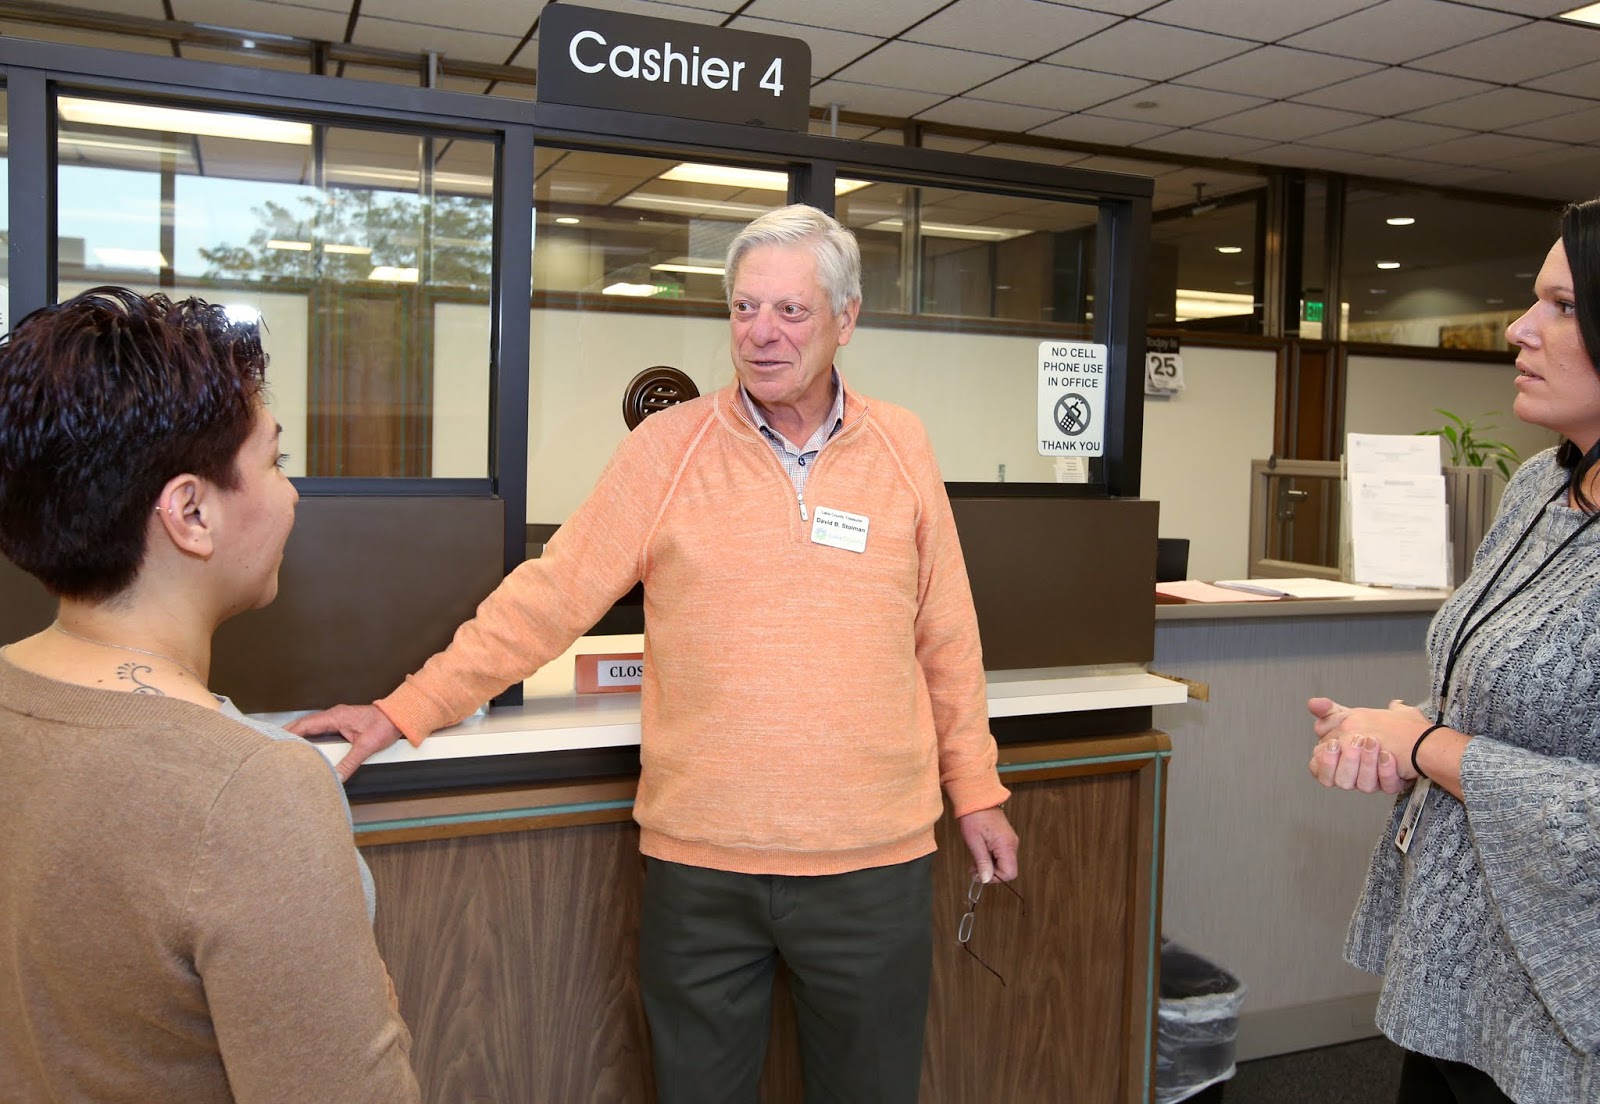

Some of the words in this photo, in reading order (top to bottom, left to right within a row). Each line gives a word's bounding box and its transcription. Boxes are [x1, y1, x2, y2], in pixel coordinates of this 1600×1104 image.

[569, 30, 745, 92] Cashier
[759, 57, 784, 97] 4
[1051, 347, 1067, 357] NO
[1070, 348, 1097, 359] CELL
[1043, 361, 1080, 373] PHONE
[1083, 363, 1104, 374] USE
[1150, 355, 1176, 378] 25
[1048, 376, 1058, 387] IN
[1061, 377, 1098, 388] OFFICE
[1042, 440, 1077, 451] THANK
[1079, 441, 1101, 451] YOU
[816, 517, 833, 525] David
[841, 523, 866, 532] Stolman
